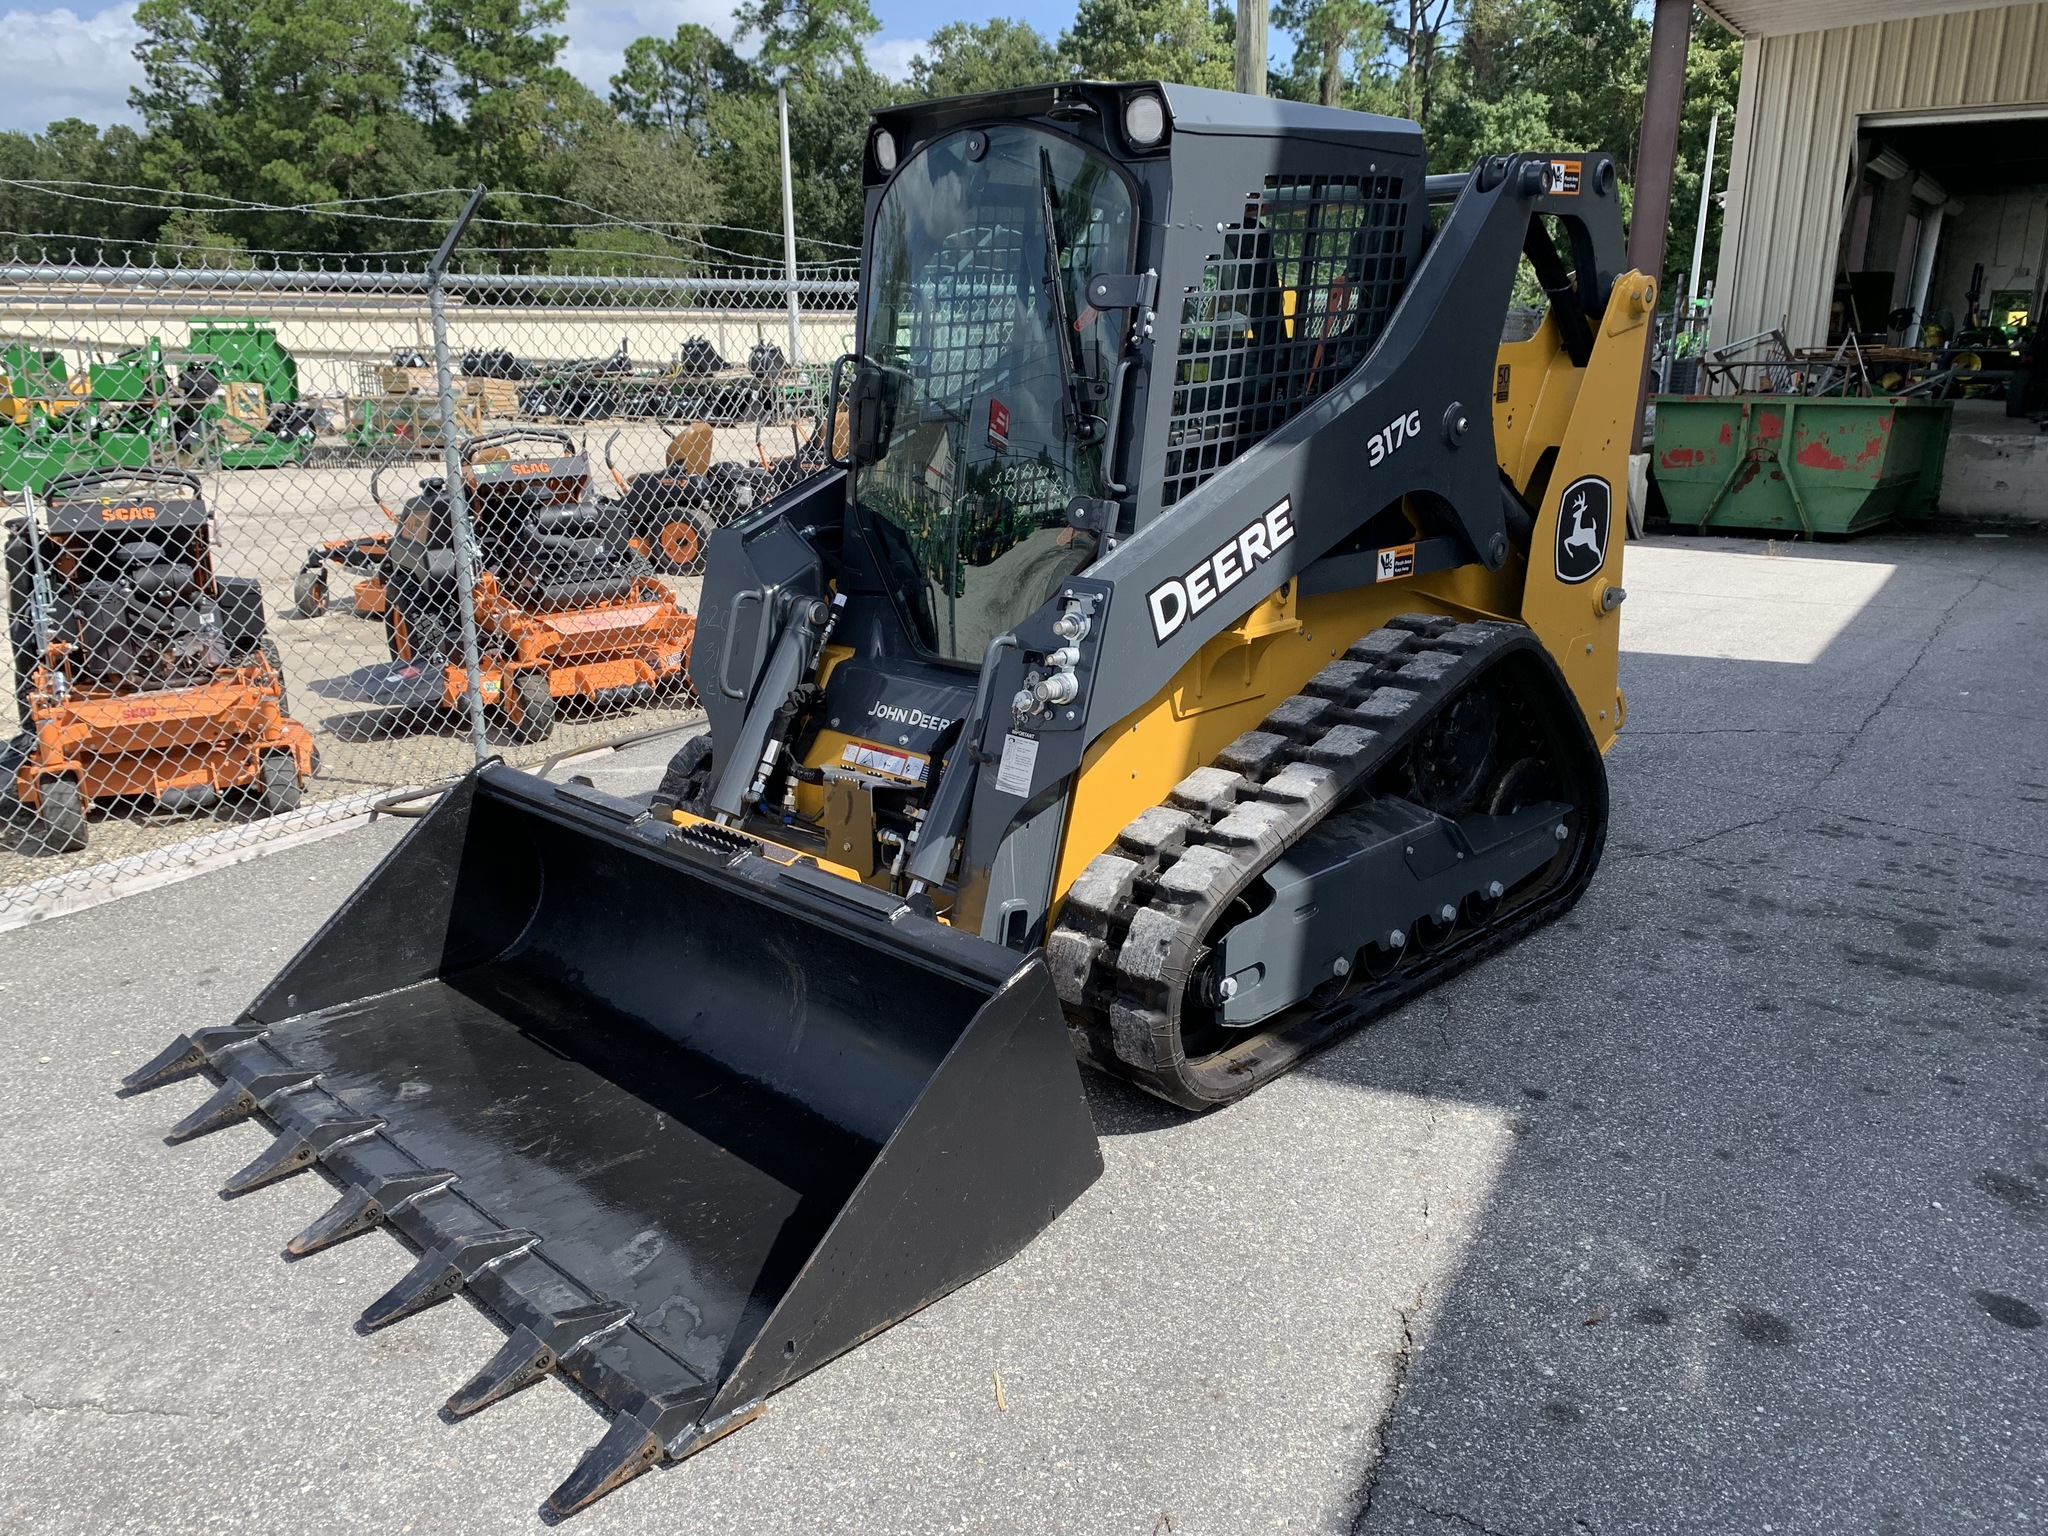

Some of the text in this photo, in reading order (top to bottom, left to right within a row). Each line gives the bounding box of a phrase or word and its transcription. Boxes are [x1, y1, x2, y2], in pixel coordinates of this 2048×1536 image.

[1366, 410, 1421, 468] 317G
[511, 462, 550, 475] SCAG
[102, 506, 156, 522] SCAG
[1149, 498, 1295, 642] DEERE
[868, 700, 958, 733] JOHN DEER
